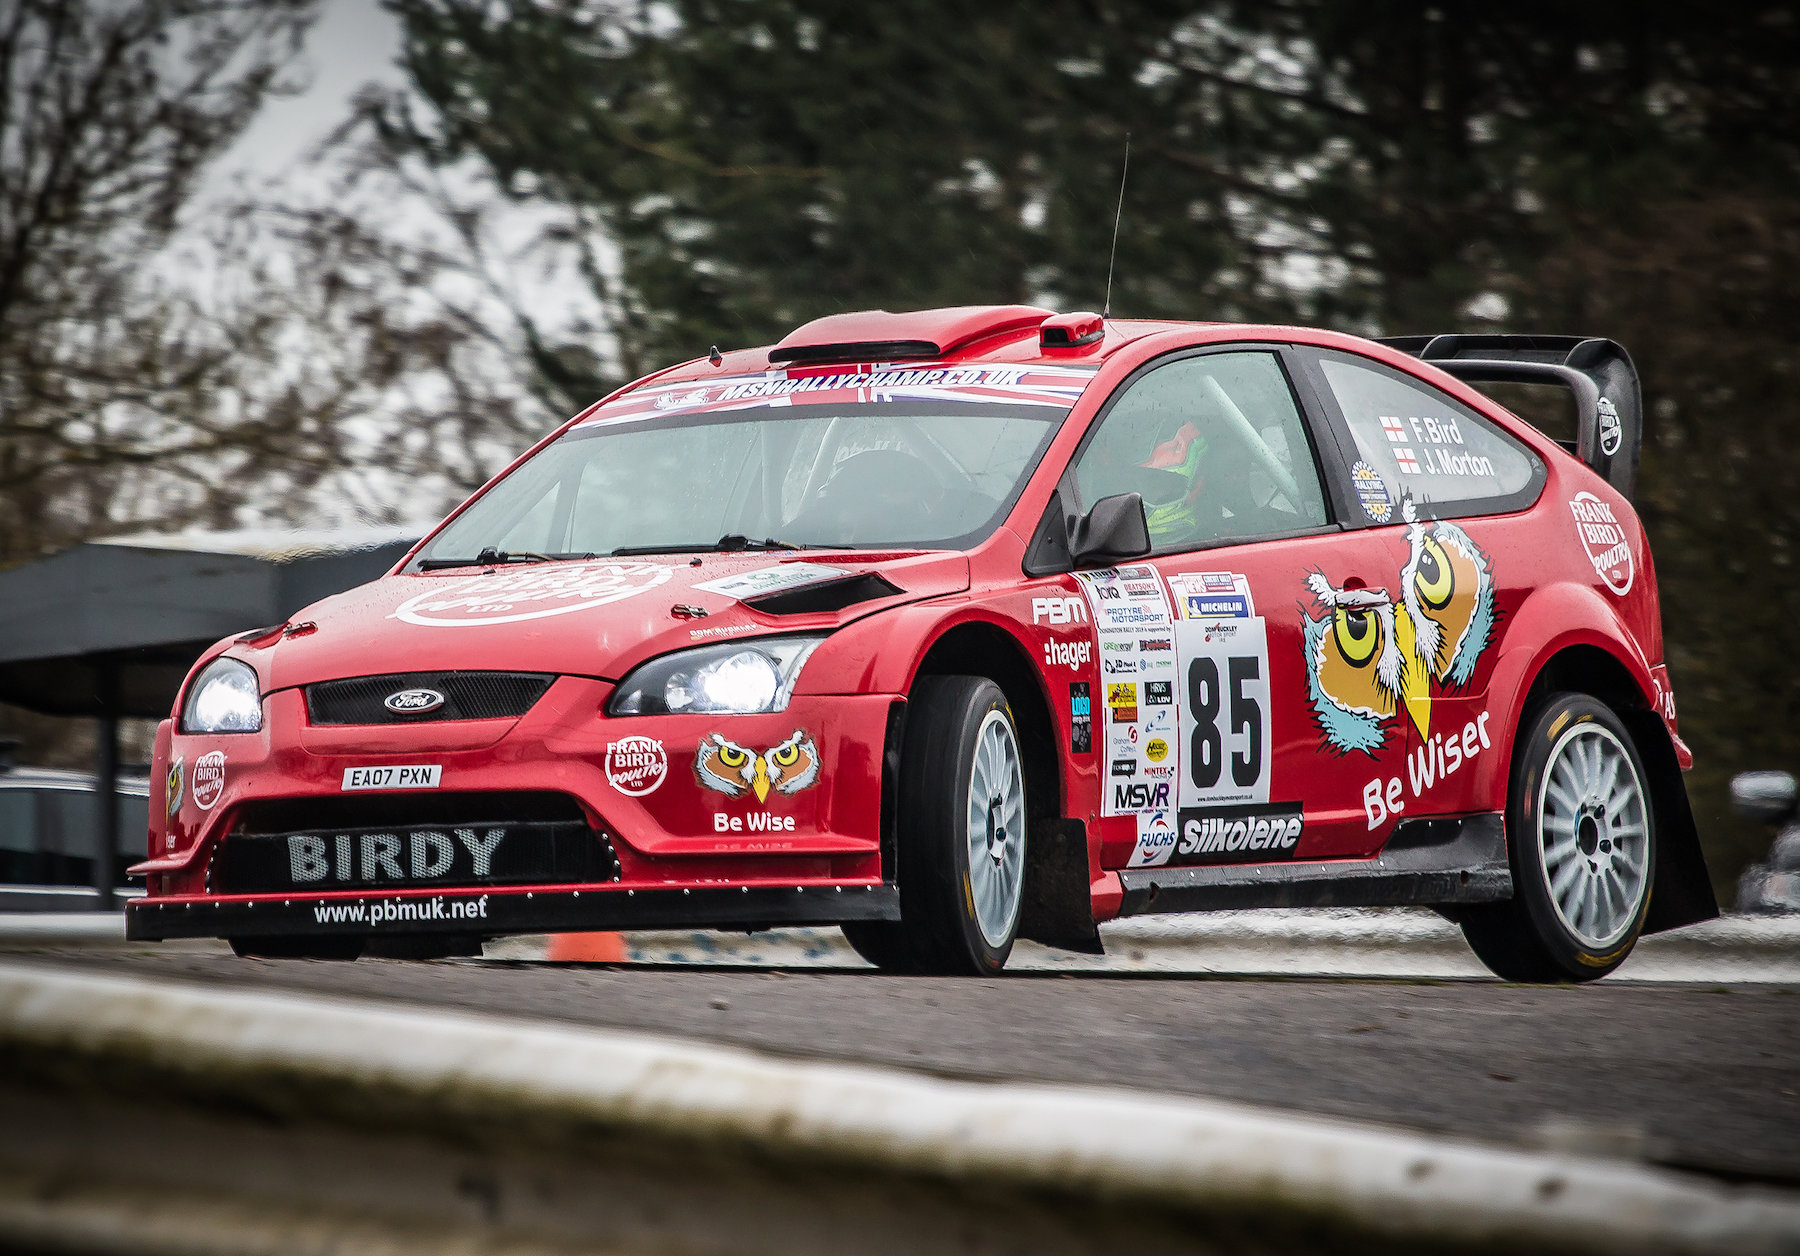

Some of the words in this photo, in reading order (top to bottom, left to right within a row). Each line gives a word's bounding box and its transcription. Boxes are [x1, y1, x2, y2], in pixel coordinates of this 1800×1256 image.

[717, 369, 1030, 401] MSNRALLYCHAMP.CO.UK
[1408, 417, 1464, 445] F.Bird
[1424, 448, 1495, 477] J.Morton
[1569, 502, 1617, 523] FRANK
[1583, 524, 1618, 544] BIRD
[1593, 541, 1628, 575] POULTRY
[466, 603, 513, 613] LTD
[1032, 597, 1088, 625] PBM
[1106, 607, 1143, 616] PROTYRE
[1200, 601, 1243, 613] MICHELIN
[1111, 613, 1164, 623] MOTORSPORT
[394, 692, 431, 707] Ford
[1187, 656, 1263, 789] 85
[607, 740, 663, 754] FRANK
[196, 755, 228, 768] FRANK
[615, 753, 656, 767] BIRD
[197, 768, 220, 780] BIRD
[351, 769, 392, 787] EA07
[399, 768, 433, 785] PXN
[609, 762, 667, 786] POULTRY
[1363, 777, 1405, 831] Be
[1407, 711, 1491, 798] Wiser
[1115, 783, 1170, 808] MSVR
[714, 812, 742, 832] Be
[747, 811, 795, 832] Wise
[1139, 832, 1176, 847] FUCHS
[1179, 816, 1302, 854] Silkolene
[288, 828, 505, 883] BIRDY
[314, 896, 488, 926] www.pbmuk.net
